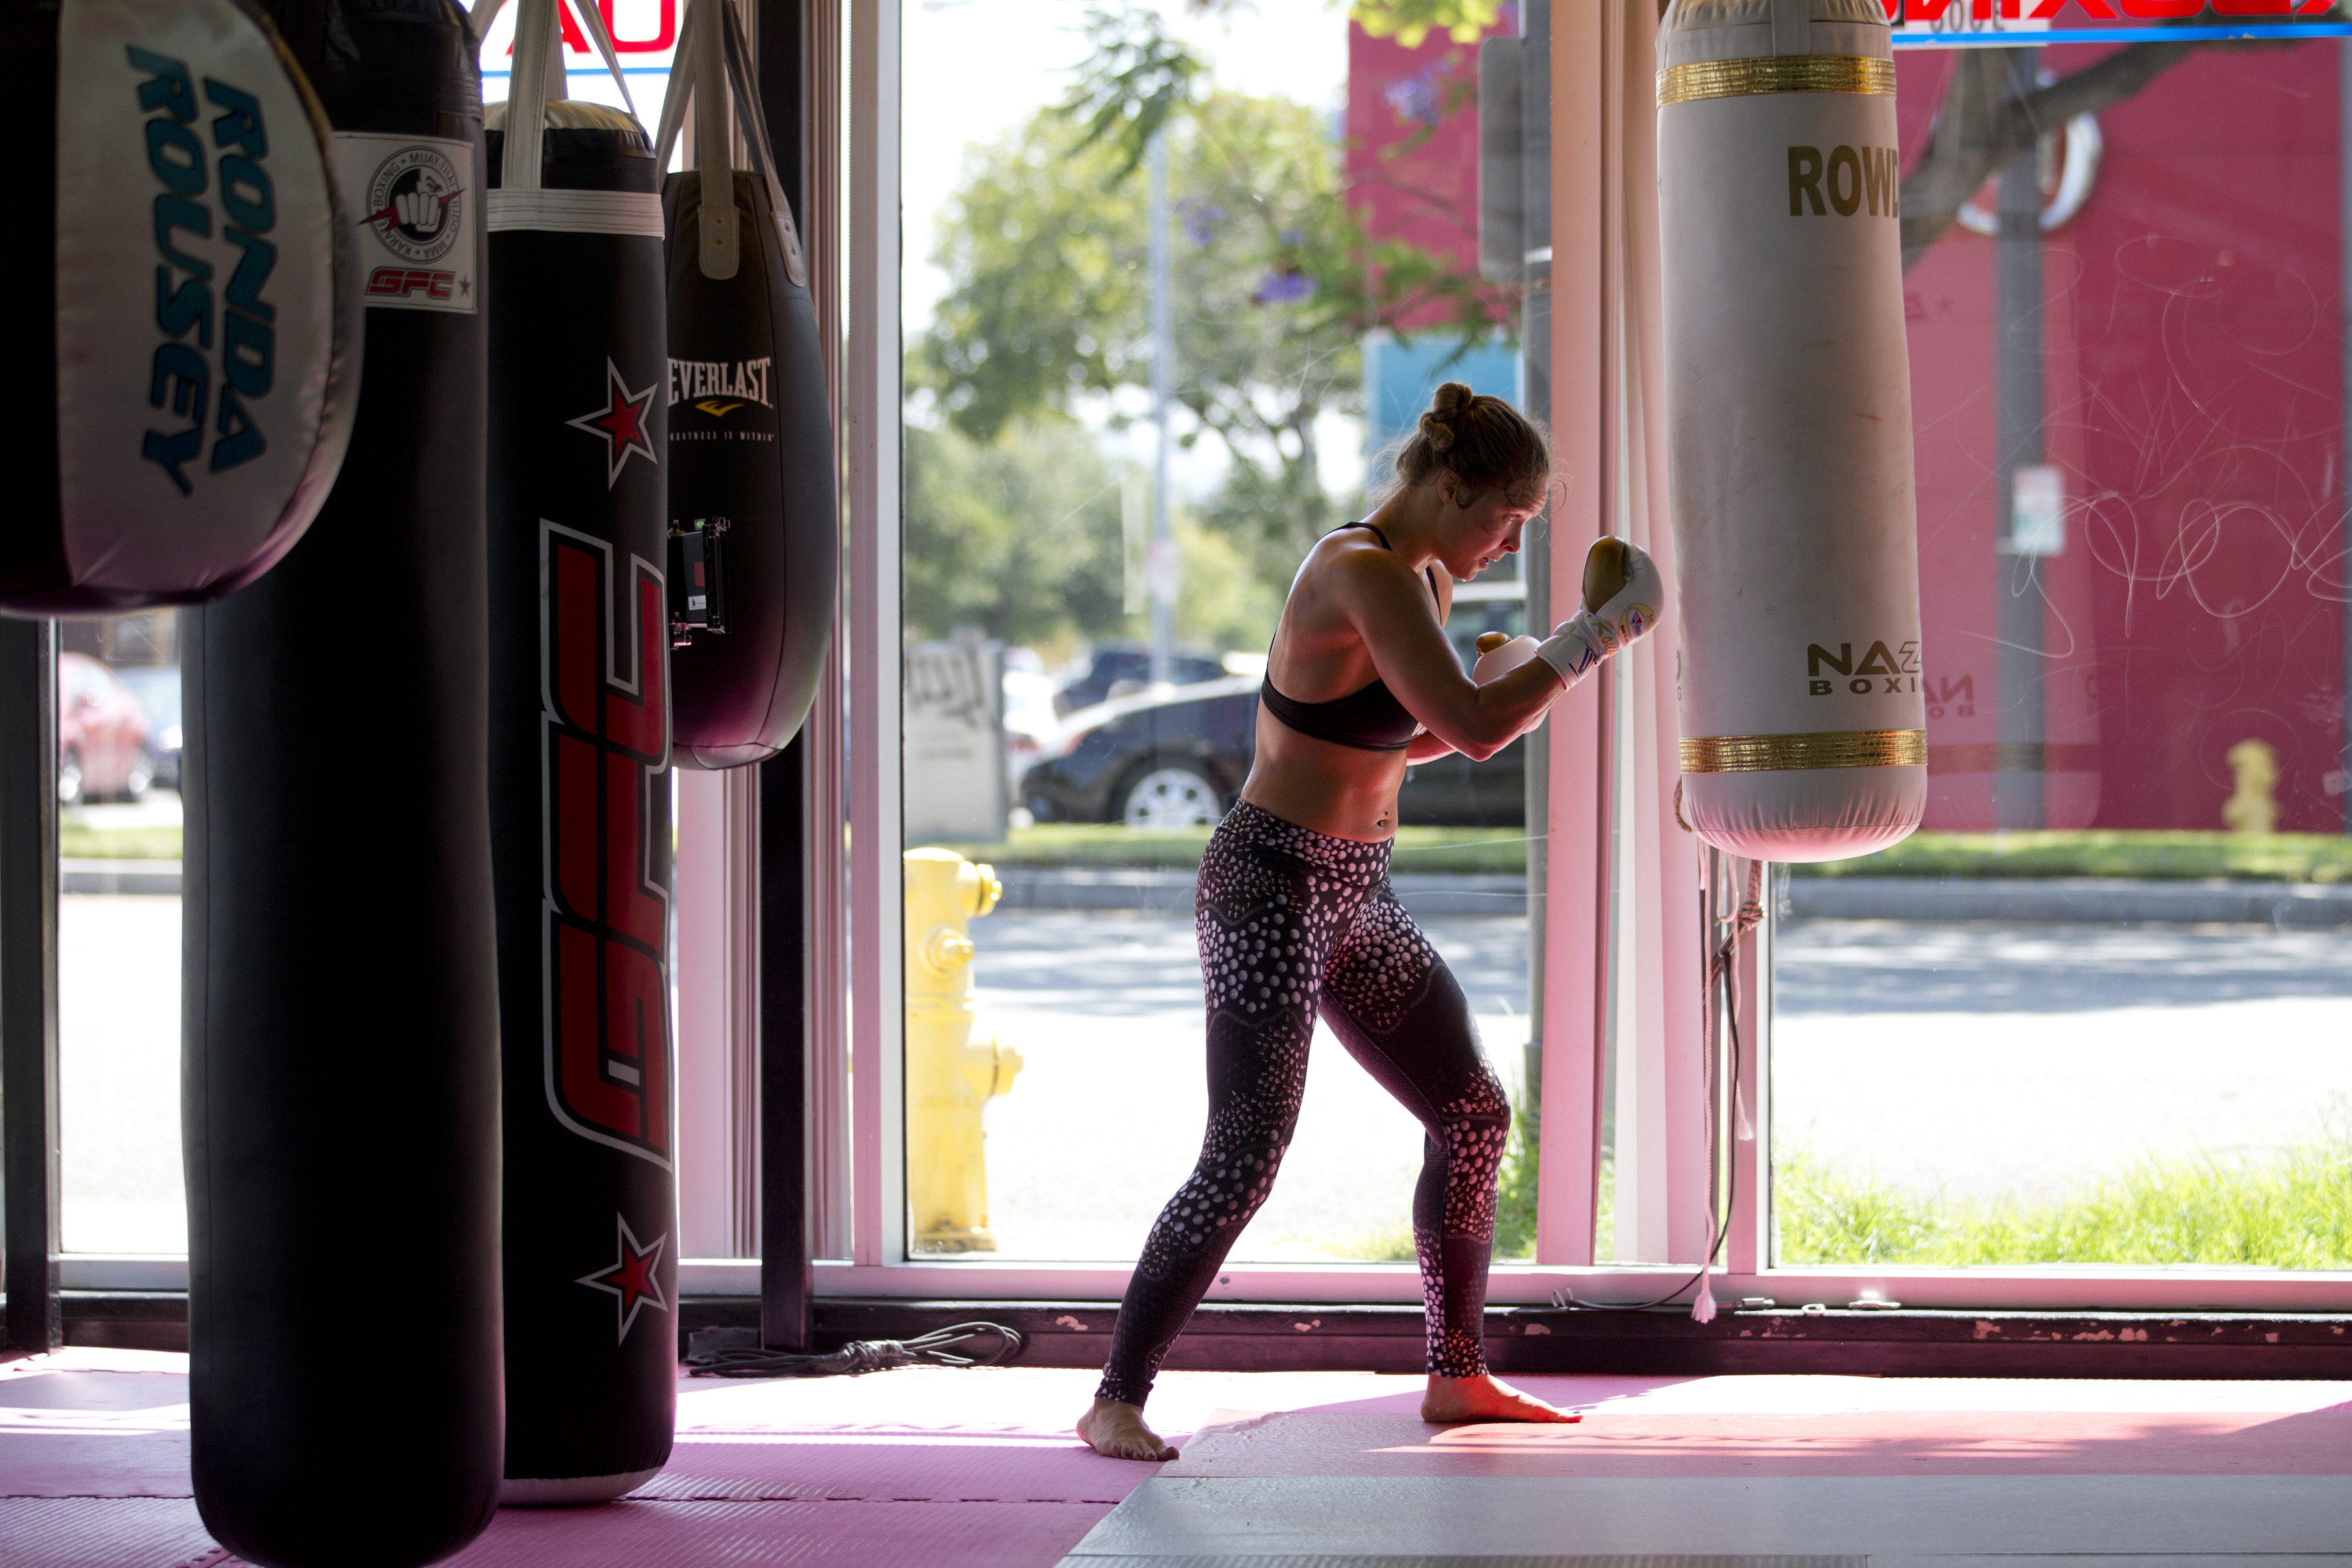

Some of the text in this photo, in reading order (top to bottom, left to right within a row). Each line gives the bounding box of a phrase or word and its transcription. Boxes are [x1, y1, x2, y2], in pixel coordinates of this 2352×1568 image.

[373, 163, 400, 206] BOXING
[125, 44, 213, 497] ROUSEY
[203, 76, 277, 474] RONDA
[366, 267, 455, 300] GFC
[668, 357, 772, 408] EVERLAST
[1809, 677, 1923, 696] BOXI
[540, 517, 674, 1173] GFC
